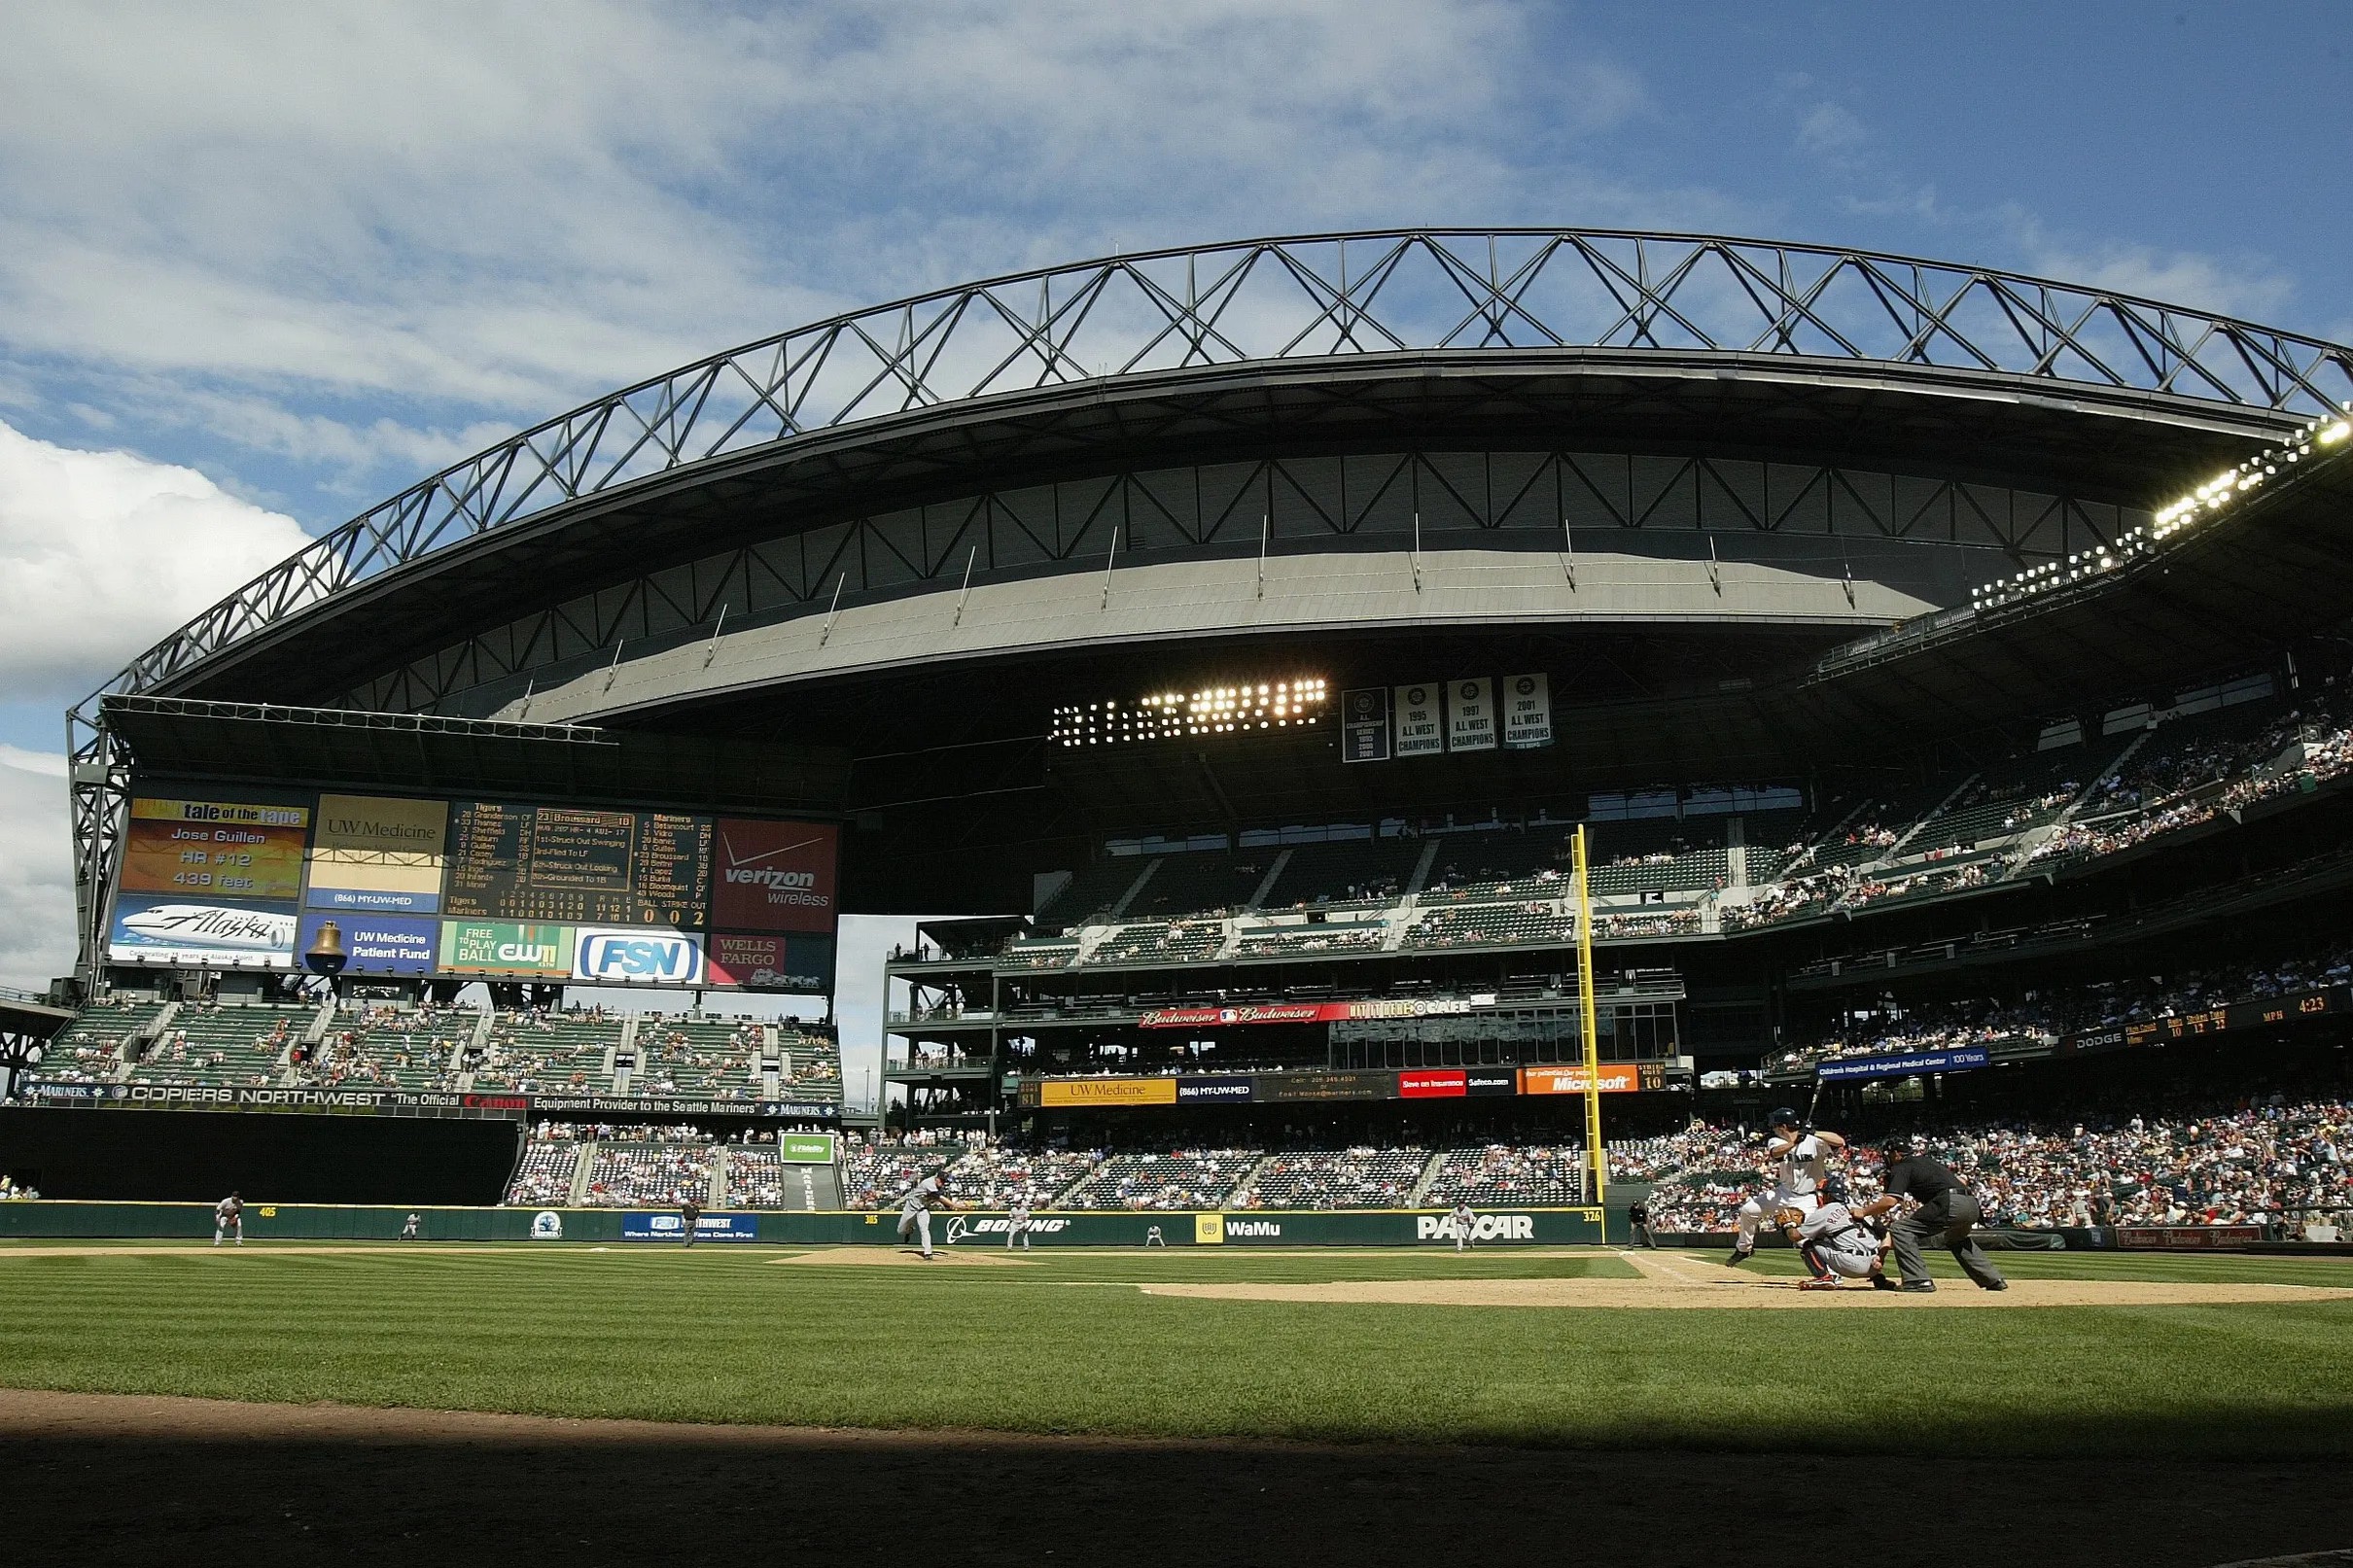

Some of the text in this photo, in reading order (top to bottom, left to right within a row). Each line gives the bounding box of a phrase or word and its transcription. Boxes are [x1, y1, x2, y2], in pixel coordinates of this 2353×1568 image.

[1462, 706, 1479, 716] 1997
[1517, 700, 1535, 711] 2001
[1410, 711, 1426, 721] 1995
[1525, 714, 1544, 724] WEST
[1416, 723, 1435, 735] WEST
[1468, 718, 1488, 729] WEST
[1452, 733, 1493, 747] CHAMPIONS
[1507, 728, 1549, 740] CHAMPIONS
[1398, 738, 1439, 751] CHAMPIONS
[475, 803, 502, 812] Tigers
[185, 805, 299, 824] tale of the tape
[539, 813, 601, 823] 23 Broussard
[329, 819, 436, 838] UW Medicine
[171, 828, 264, 844] Jose Guillen
[592, 838, 625, 848] Swinging
[181, 852, 251, 866] HR #12
[173, 873, 253, 888] 439 feet
[725, 866, 814, 891] verizon
[358, 896, 411, 905] MY-UW-MED
[449, 896, 476, 905] Tigers
[767, 891, 828, 906] wireless
[644, 909, 704, 925] 0 0 2
[161, 910, 270, 938] Alaska
[354, 931, 426, 945] UW Medicine
[467, 928, 493, 938] FREE
[470, 940, 497, 950] PLAY
[720, 939, 776, 952] WELLS
[353, 947, 430, 959] Patient Fund
[459, 949, 496, 961] BALL
[599, 940, 681, 975] FSN
[720, 953, 775, 965] FARGO
[1426, 1001, 1470, 1013] CAFE
[2299, 996, 2324, 1013] 4:23
[1142, 1011, 1216, 1027] Budweiser
[1239, 1007, 1315, 1022] Budweiser
[2264, 1010, 2283, 1022] MPH
[2172, 1028, 2182, 1037] 10
[2076, 1032, 2122, 1049] DODGE
[1965, 1054, 1984, 1063] Years
[1845, 1065, 1869, 1075] Hospital
[1877, 1062, 1901, 1072] Regional
[1645, 1077, 1661, 1089] 10
[40, 1085, 88, 1098] MARINERS
[1071, 1083, 1144, 1096] UW Medicine
[1200, 1085, 1249, 1096] MY-UW-MED
[131, 1087, 386, 1106] COPIERS NORTHWEST
[1022, 1094, 1035, 1104] 81
[421, 1095, 459, 1106] Official
[464, 1095, 527, 1109] Canon
[534, 1097, 590, 1111] Equipment
[593, 1098, 638, 1111] Provider
[641, 1100, 651, 1111] to
[654, 1100, 670, 1111] the
[672, 1100, 708, 1112] Seattle
[781, 1104, 821, 1116] MARINERS
[259, 1207, 276, 1217] 405
[1583, 1211, 1600, 1222] 326
[974, 1220, 1064, 1232] BONG
[1227, 1221, 1281, 1237] WaMu
[1418, 1215, 1533, 1239] PACAR
[2122, 1231, 2157, 1245] Budweiser
[2162, 1231, 2201, 1245] Budweiser
[2209, 1230, 2253, 1245] Budweiser
